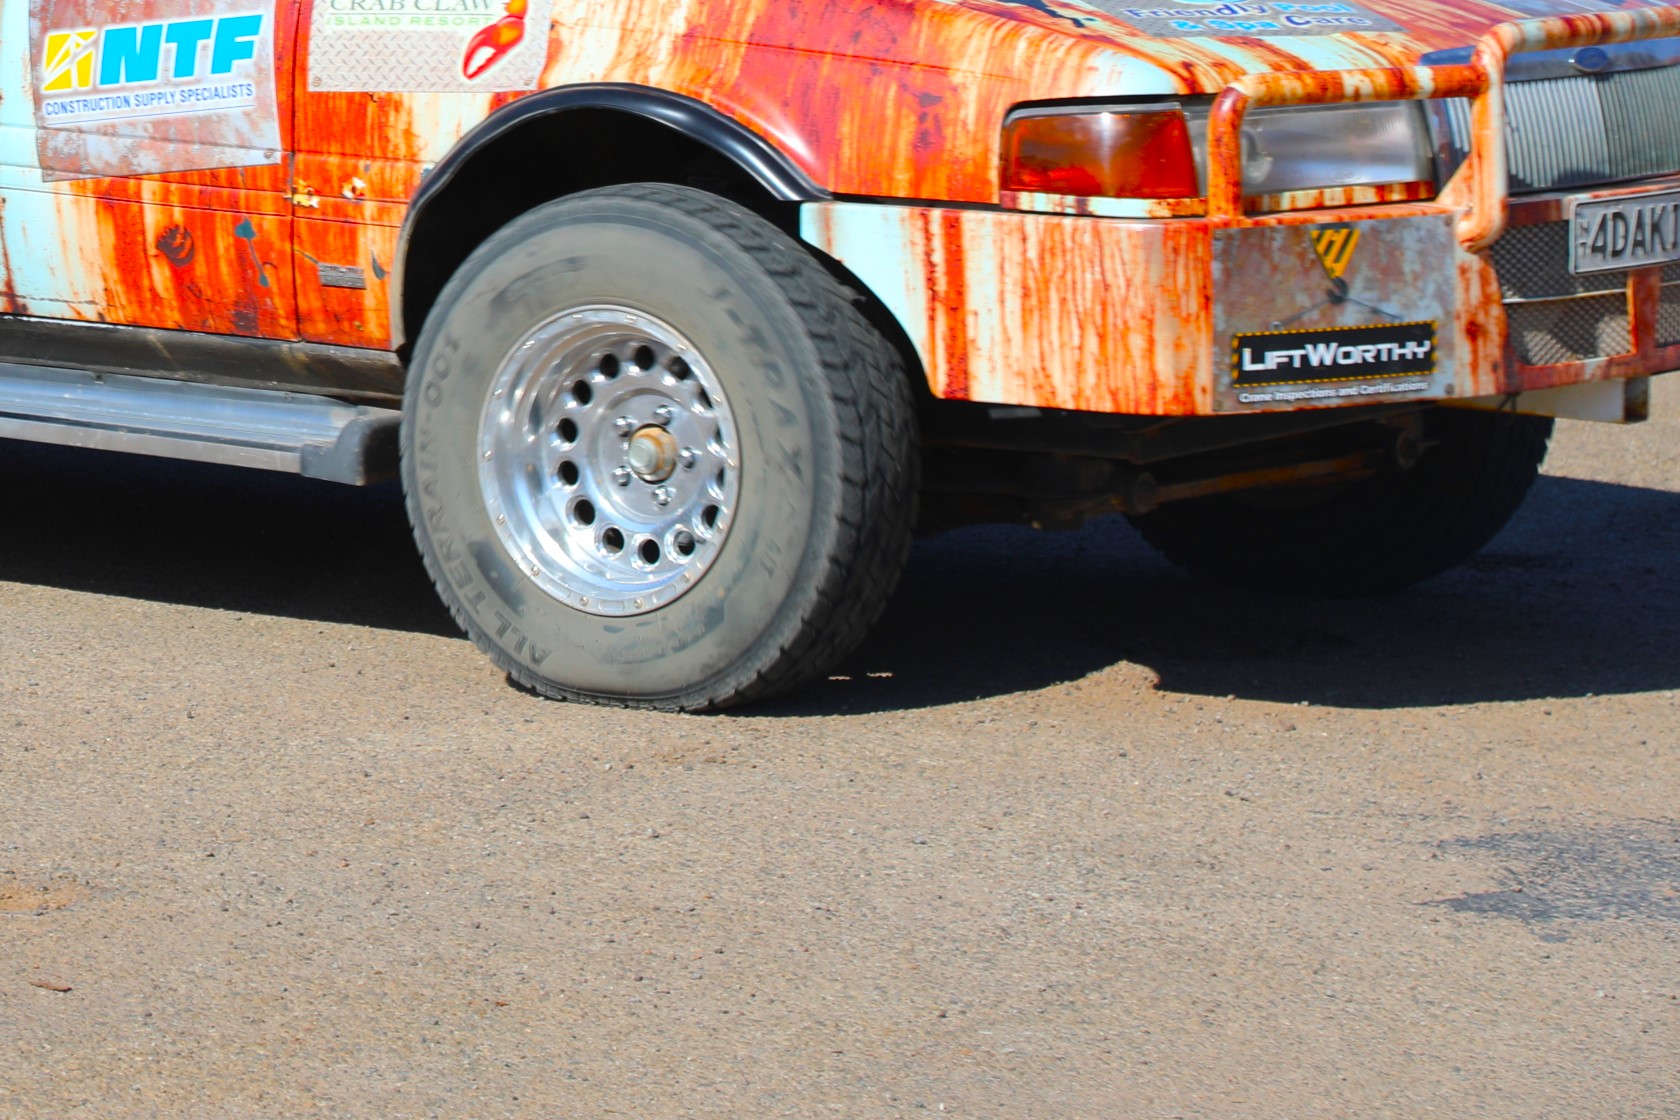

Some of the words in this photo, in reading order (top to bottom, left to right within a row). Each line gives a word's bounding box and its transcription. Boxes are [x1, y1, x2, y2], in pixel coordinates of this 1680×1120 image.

[1124, 2, 1268, 19] Friendly
[1269, 1, 1358, 14] Pool
[326, 15, 402, 27] ISLAND
[410, 16, 494, 27] RESORT
[1204, 17, 1282, 32] Spa
[1283, 14, 1373, 27] Care
[99, 14, 264, 86] NTF
[45, 95, 131, 116] CONSTRUCTION
[134, 89, 177, 108] SUPPLY
[179, 83, 254, 103] SPECIALISTS
[1238, 391, 1273, 404] Crane
[1273, 387, 1337, 403] Inspections
[1337, 385, 1359, 398] and
[1359, 381, 1429, 396] Certifications
